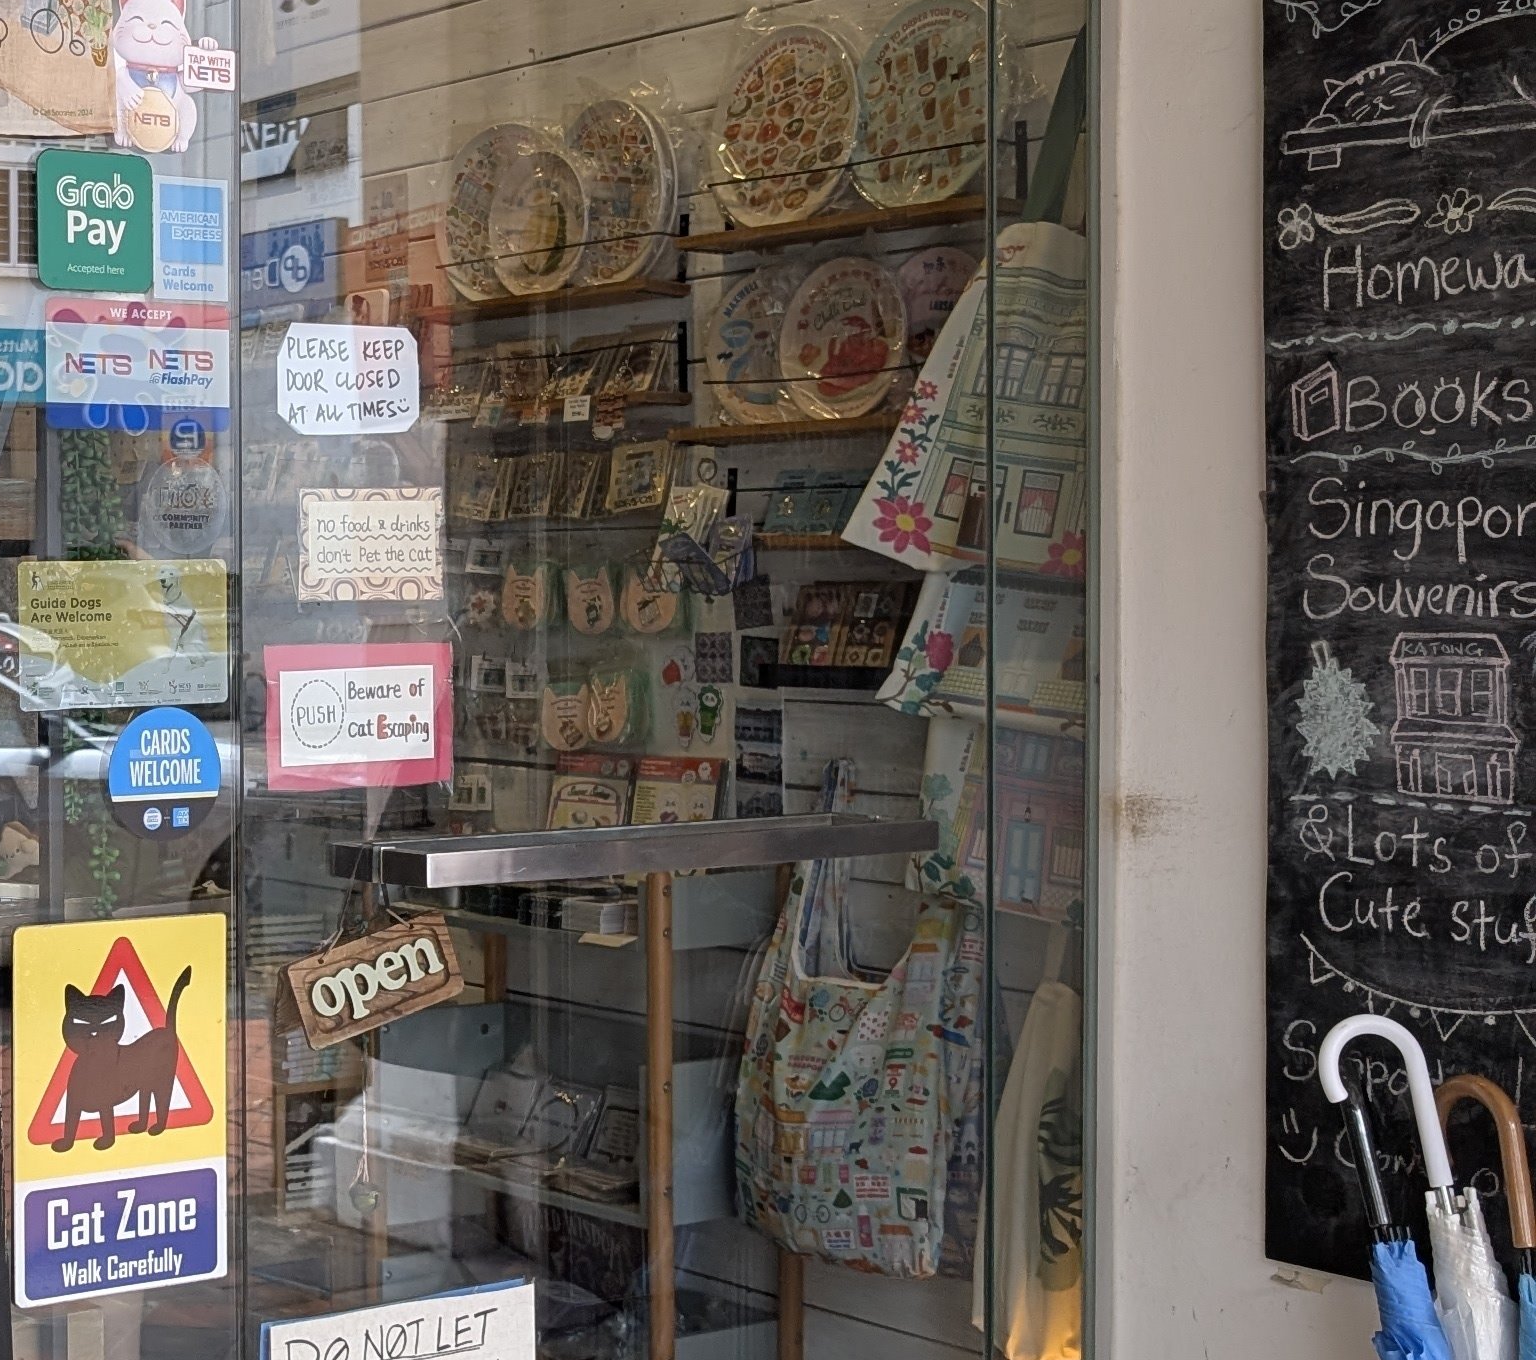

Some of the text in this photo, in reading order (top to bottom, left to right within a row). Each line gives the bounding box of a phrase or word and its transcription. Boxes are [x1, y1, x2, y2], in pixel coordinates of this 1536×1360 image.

[188, 53, 231, 67] TAP WITH
[188, 64, 231, 84] NETS
[133, 111, 171, 129] NETS
[56, 172, 135, 211] Grab
[160, 211, 219, 225] AMERICAN
[66, 209, 127, 255] Pay
[172, 227, 222, 240] EXPRESS
[66, 262, 125, 275] Accepted here
[162, 265, 197, 277] Cards
[162, 279, 214, 292] Welcome
[110, 307, 173, 320] WE ACCEPT
[286, 336, 405, 362] PLEASE KEEP
[65, 348, 214, 376] NETS NETS
[161, 372, 214, 389] FlashPay
[286, 368, 401, 393] DOOR CLOSED
[288, 399, 398, 425] AT ALL TIMES
[316, 518, 336, 533] no
[340, 515, 372, 533] food
[390, 513, 430, 533] drinks
[316, 545, 352, 564] don't
[385, 546, 405, 562] the
[30, 597, 102, 611] Guide Dogs
[30, 610, 113, 624] Are Welcome
[1400, 640, 1485, 657] KATONG
[347, 677, 426, 701] Beware of
[296, 704, 337, 727] PUSH
[376, 713, 430, 743] Escaping
[140, 728, 191, 756] CARDS
[129, 758, 202, 788] WELCOME
[1475, 820, 1534, 879] of
[1319, 871, 1431, 939] Cute
[310, 936, 445, 1021] open
[47, 1188, 198, 1251] Cat Zone
[61, 1247, 184, 1288] Walk Carefully
[436, 1307, 499, 1352] LET
